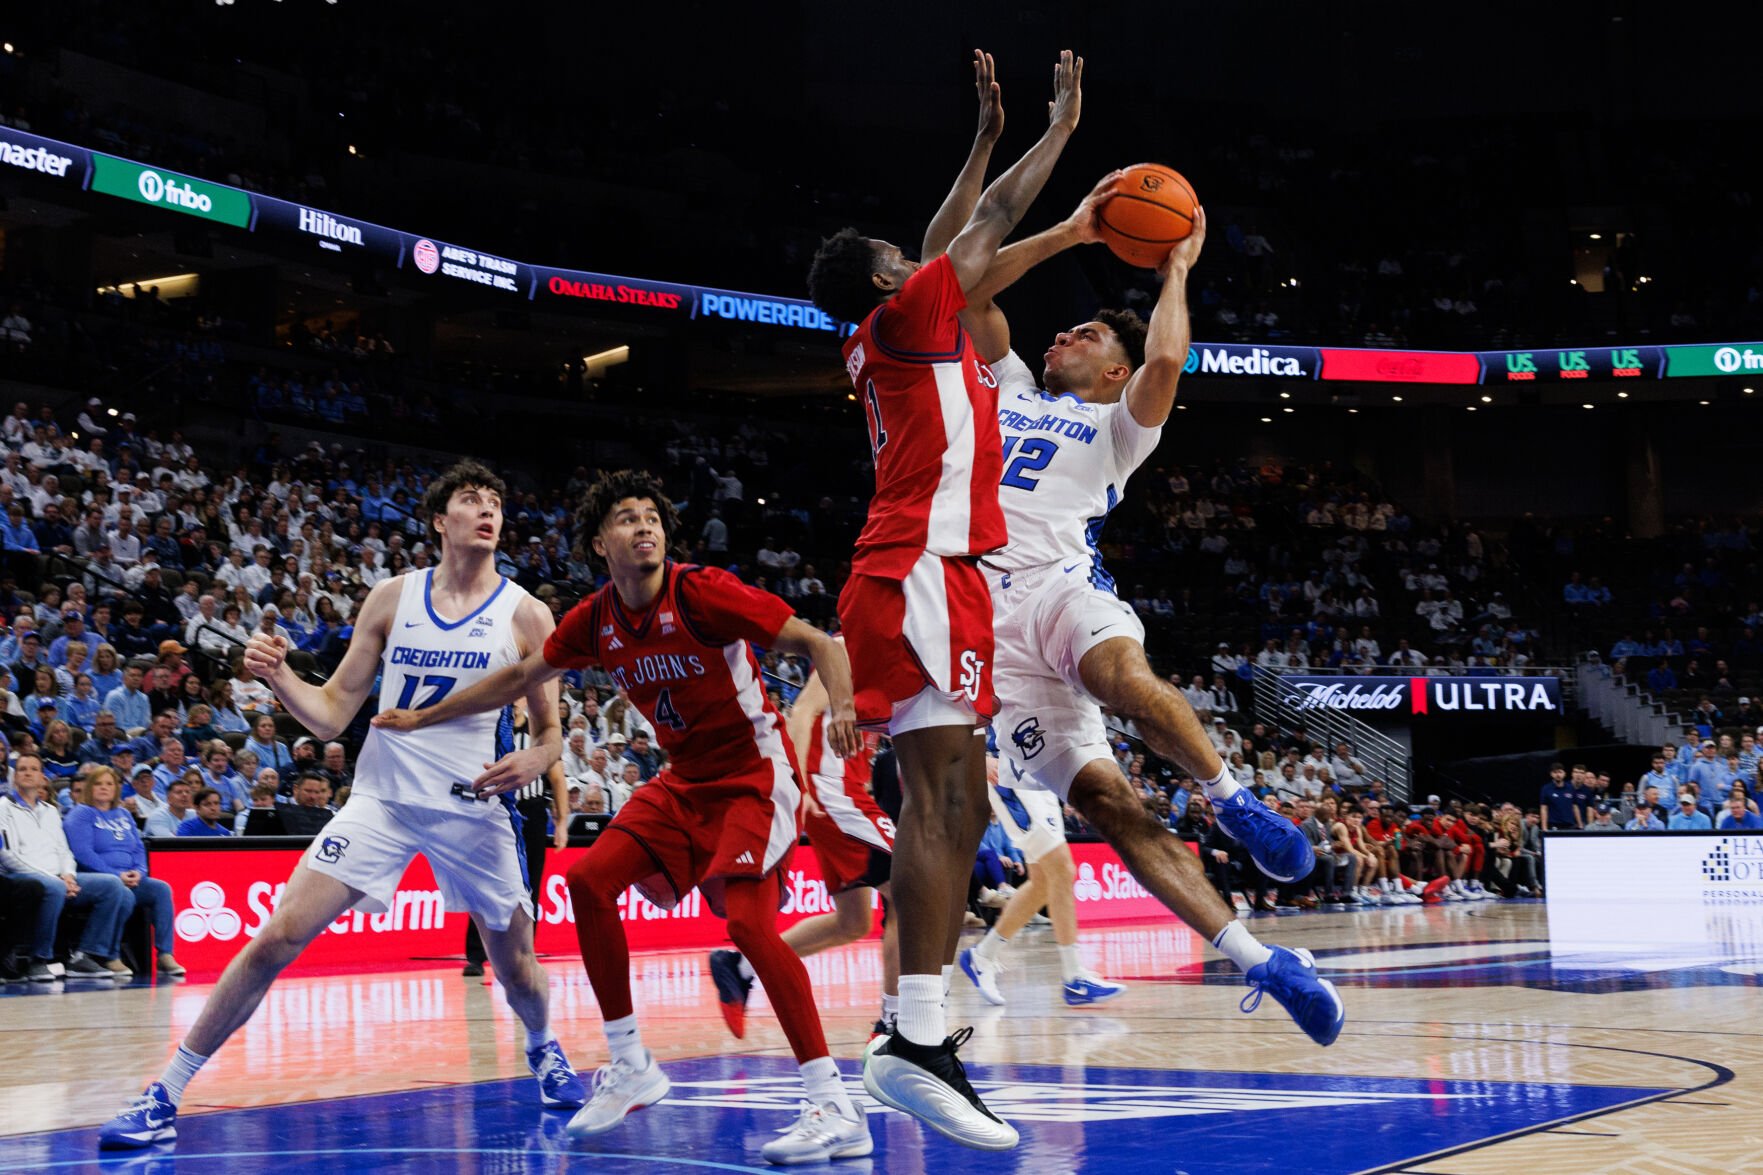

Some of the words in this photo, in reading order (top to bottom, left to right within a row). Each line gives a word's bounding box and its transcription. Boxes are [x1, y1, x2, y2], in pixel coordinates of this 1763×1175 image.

[165, 179, 212, 212] fnbo
[299, 207, 365, 246] Hilton
[441, 262, 493, 286] SERVICE
[549, 277, 616, 301] OMAHA
[617, 285, 680, 309] STEAKS
[702, 293, 837, 331] POWERADE
[391, 646, 491, 669] CREIGHTON
[633, 655, 705, 684] JOHN'S
[395, 673, 457, 711] 17
[1283, 683, 1406, 711] Michelob
[1434, 683, 1552, 711] ULTRA
[655, 688, 686, 731] 4
